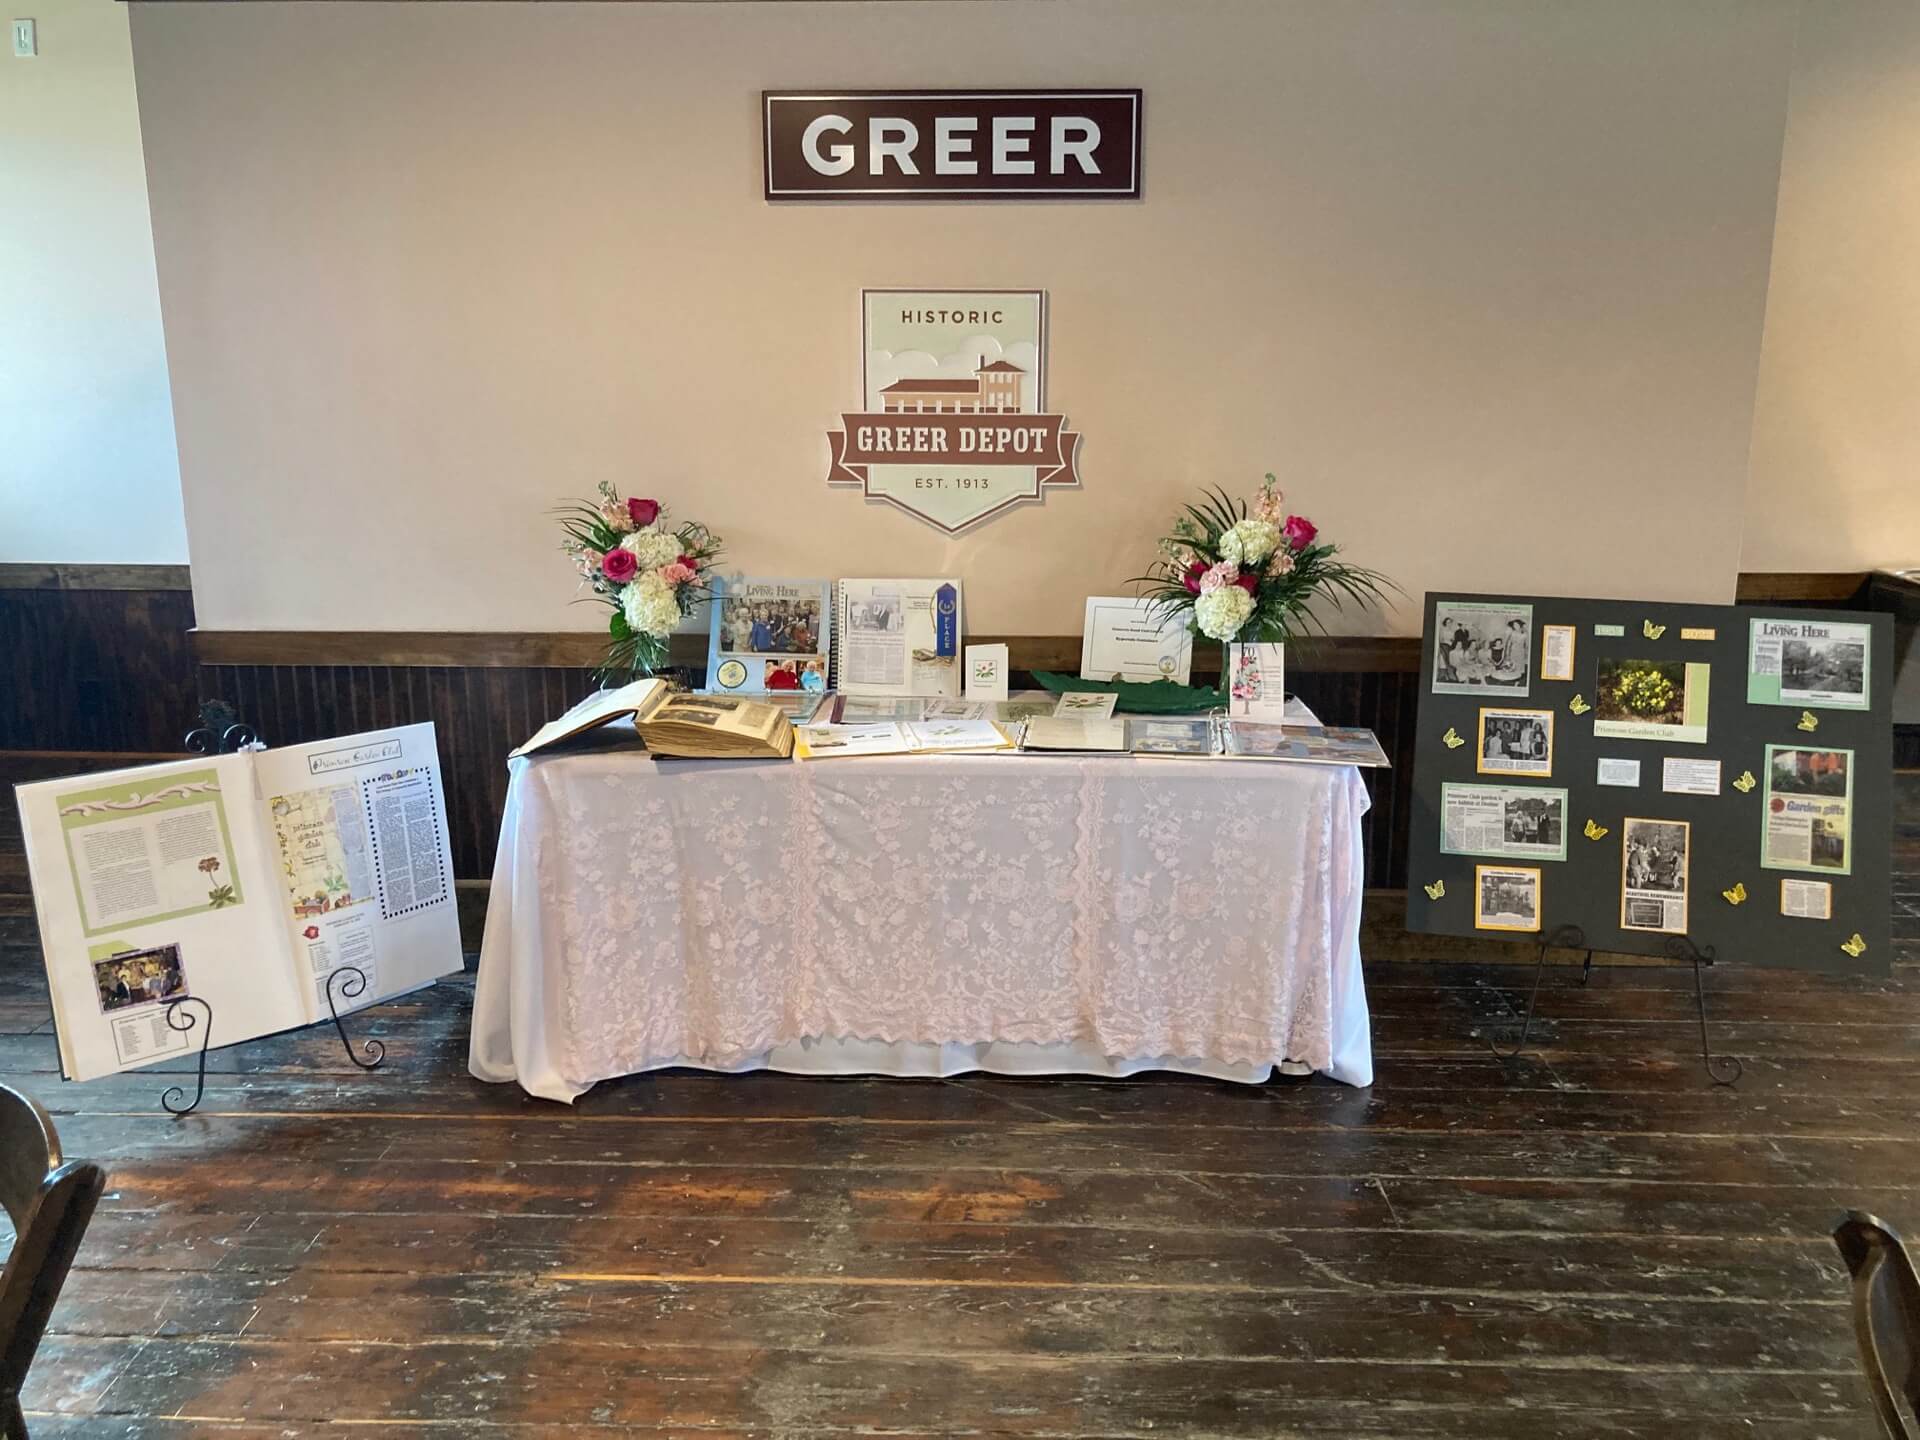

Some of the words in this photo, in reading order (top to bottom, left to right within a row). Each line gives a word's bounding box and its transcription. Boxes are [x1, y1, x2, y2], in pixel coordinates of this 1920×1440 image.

[802, 114, 1101, 176] GREER
[901, 310, 1003, 324] HISTORIC
[857, 426, 948, 452] GREER
[959, 427, 1047, 453] DEPOT
[915, 478, 948, 489] EST.
[956, 478, 989, 489] 1913
[1786, 800, 1822, 813] Garden
